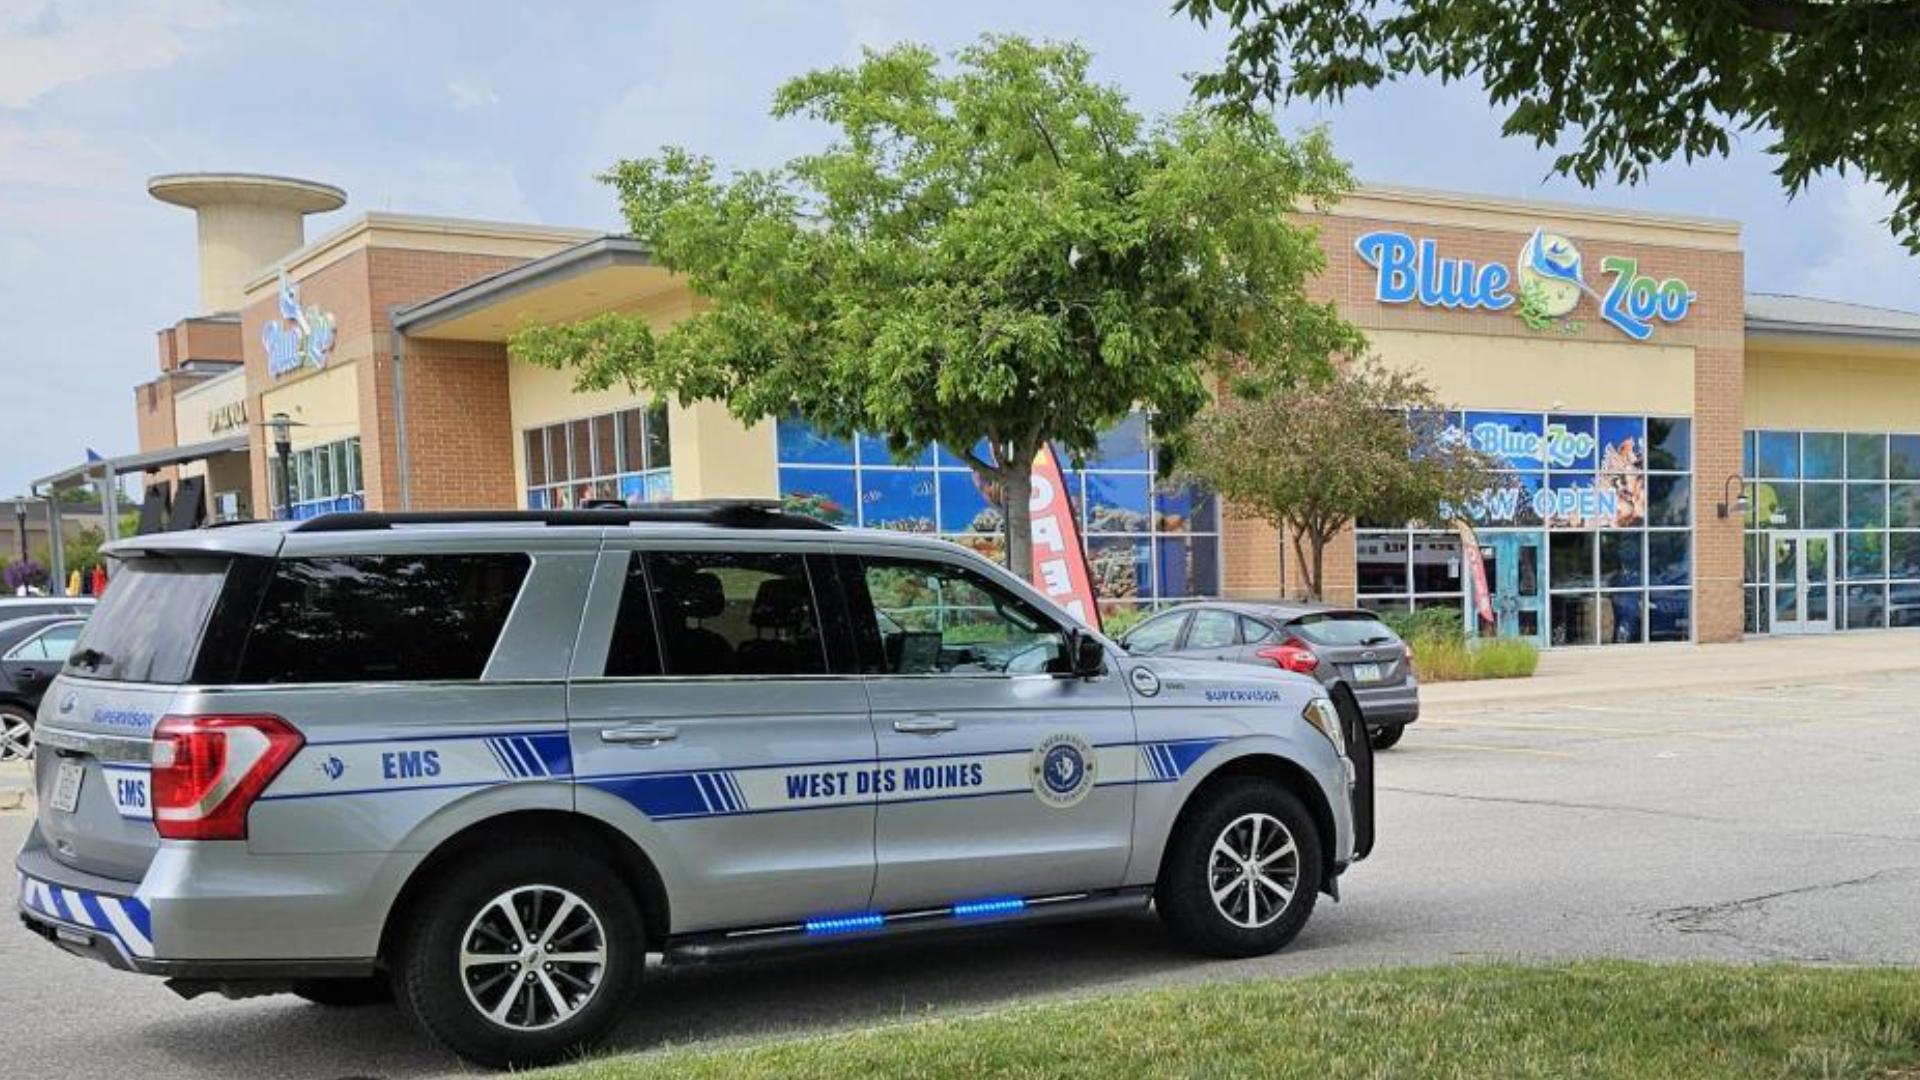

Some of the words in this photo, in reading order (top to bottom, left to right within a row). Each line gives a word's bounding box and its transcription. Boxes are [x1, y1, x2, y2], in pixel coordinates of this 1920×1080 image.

[1355, 231, 1515, 310] Blue
[1601, 256, 1697, 340] Zoo
[1472, 422, 1541, 458] Blue
[1547, 424, 1597, 467] Zoo
[1533, 487, 1617, 520] OPEN
[1205, 690, 1281, 702] SUPERVISOR
[383, 749, 441, 780] EMS
[117, 777, 146, 808] EMS
[787, 771, 849, 800] WEST
[856, 768, 897, 795] DES
[904, 763, 983, 791] MOINES
